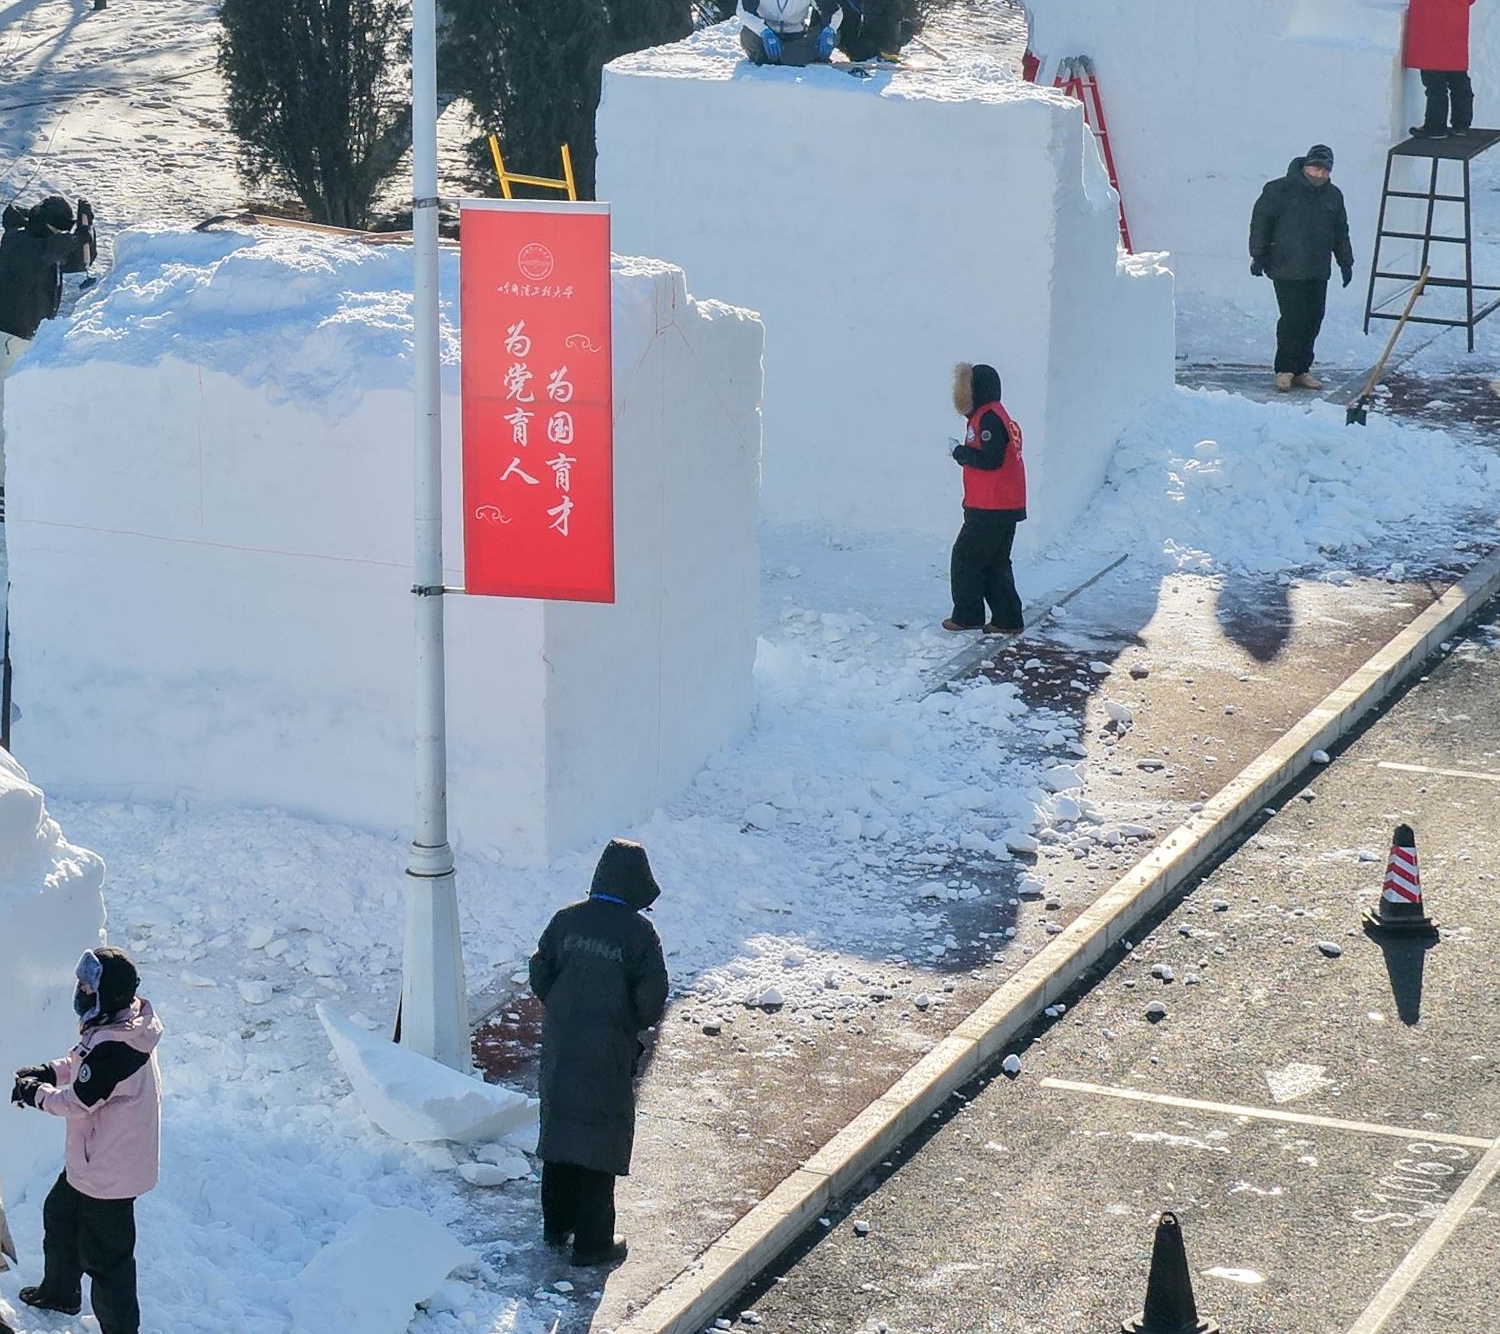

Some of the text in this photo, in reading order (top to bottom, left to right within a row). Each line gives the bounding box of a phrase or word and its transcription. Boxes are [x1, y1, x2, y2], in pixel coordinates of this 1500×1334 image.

[500, 319, 540, 487] 为党育人
[545, 364, 577, 537] 为国育才
[564, 935, 624, 963] CHINA
[1352, 1142, 1470, 1227] S1063
